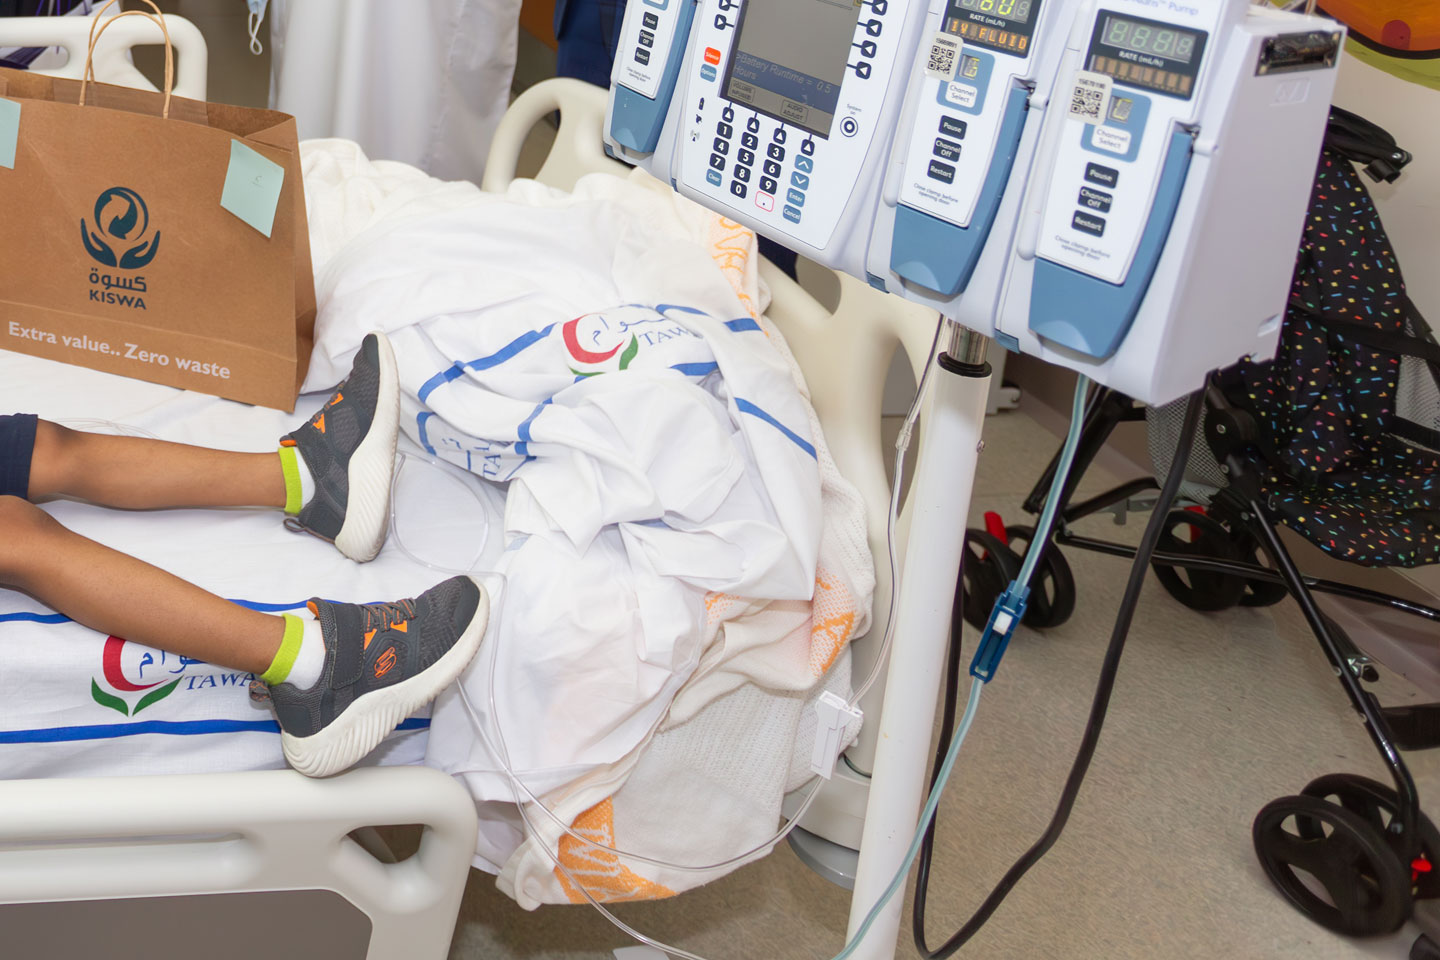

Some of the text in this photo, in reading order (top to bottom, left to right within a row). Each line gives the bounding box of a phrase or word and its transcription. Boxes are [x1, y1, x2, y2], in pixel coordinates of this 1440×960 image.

[1168, 1, 1199, 16] Pump
[969, 13, 985, 22] RATE
[978, 27, 1028, 50] FLUID
[1119, 51, 1138, 61] RATE
[734, 66, 758, 80] Hours
[949, 84, 976, 97] Channel
[951, 93, 970, 103] Select
[723, 126, 728, 135] 1
[943, 121, 962, 133] Pause
[746, 136, 753, 146] 2
[1096, 129, 1128, 142] Channel
[718, 142, 724, 151] 4
[772, 147, 779, 157] 3
[935, 140, 960, 153] Channel
[743, 153, 749, 162] 5
[941, 149, 952, 157] Off
[714, 157, 721, 166] 7
[739, 169, 746, 178] 8
[769, 164, 775, 174] 6
[930, 165, 952, 178] Restart
[1089, 169, 1113, 182] Pause
[736, 184, 742, 194] 0
[765, 180, 772, 190] 9
[789, 191, 803, 202] Enter
[1080, 188, 1113, 204] Channel
[1087, 199, 1101, 208] Off
[783, 208, 800, 220] Cancel
[89, 267, 147, 292] كسوة
[89, 289, 147, 310] KISWA
[639, 326, 690, 347] TAW
[9, 321, 231, 379] Extra value.. Zero waste
[184, 672, 257, 691] TAWA
